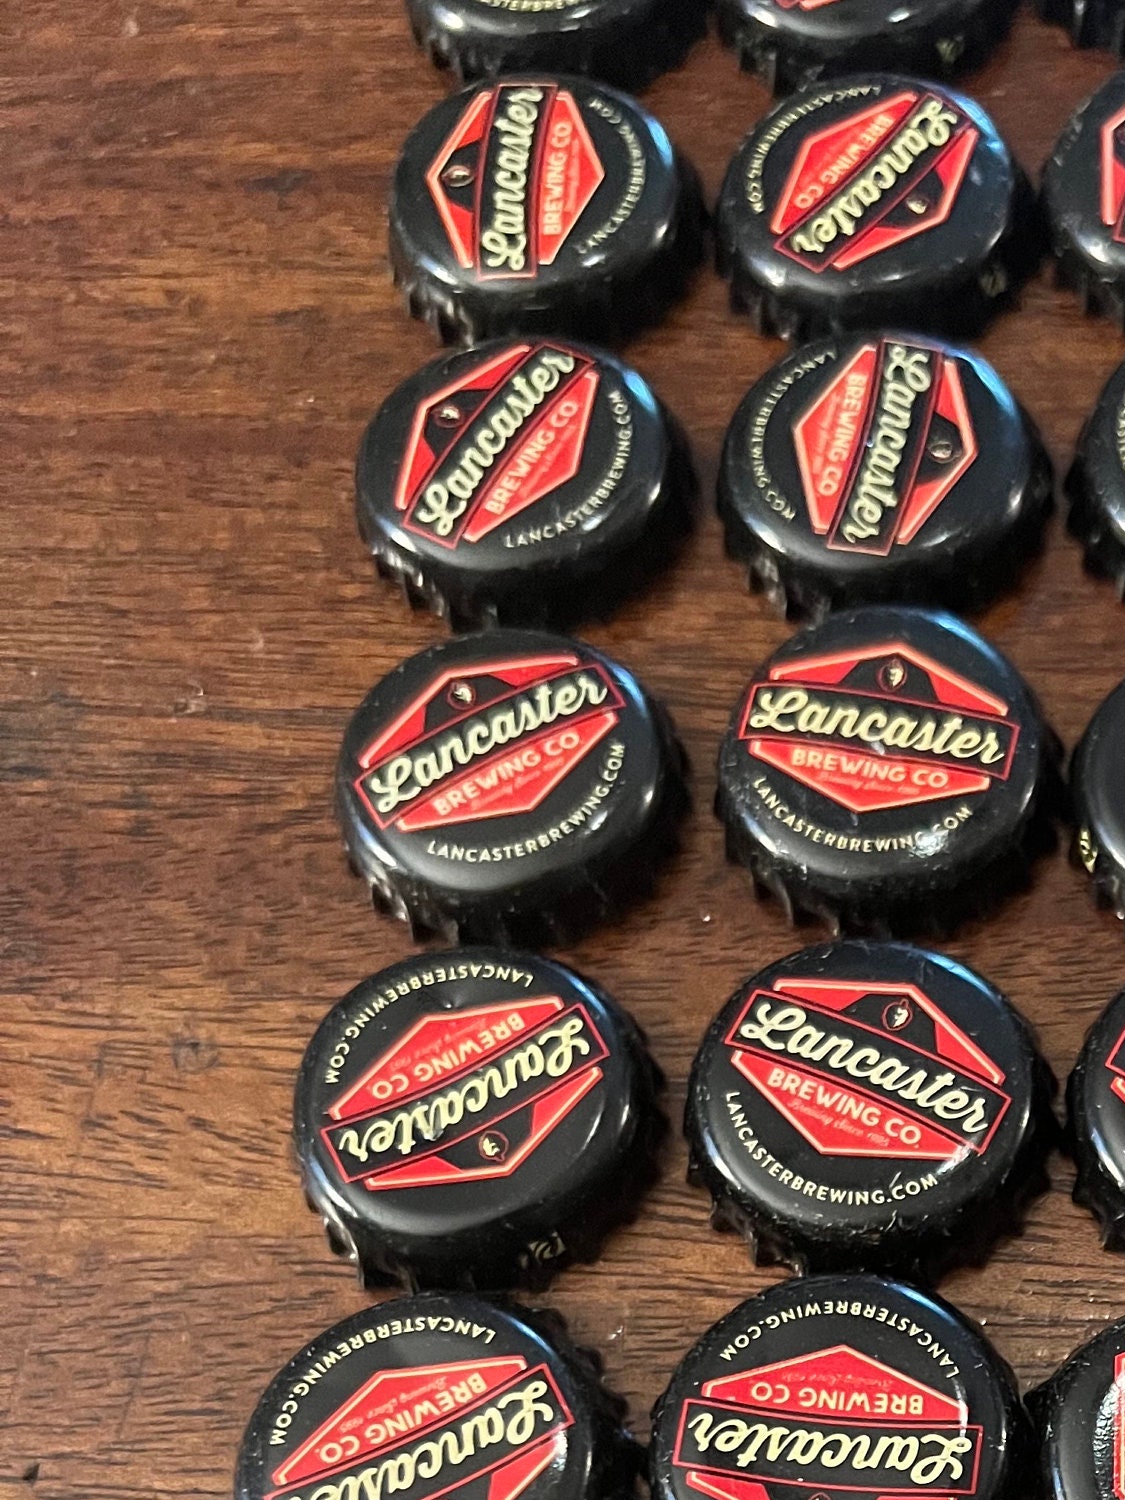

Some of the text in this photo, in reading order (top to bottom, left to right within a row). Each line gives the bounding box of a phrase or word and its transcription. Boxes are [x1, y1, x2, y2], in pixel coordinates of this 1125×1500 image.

[481, 88, 542, 268] Lancaster
[796, 101, 957, 250] Lancaster
[418, 355, 572, 533] Lancaster
[841, 347, 928, 542] Lancaster
[371, 677, 604, 811] Lancaster
[433, 751, 540, 815] BREWING
[748, 692, 1005, 765] Lancaster
[789, 748, 903, 780] BREWING
[425, 744, 624, 860] LANCASTERBREWING.COM
[327, 964, 533, 1084] LANCASTERBREWING.COM
[412, 1012, 525, 1079] BREWING
[739, 1003, 988, 1132] Lancaster
[341, 1019, 590, 1161] Lancaster
[767, 1067, 881, 1126] BREWING
[725, 1092, 938, 1204] LANCASTERBREWING.COM
[271, 1317, 496, 1444] LANCASTERBREWING.COM
[720, 1300, 960, 1377] LANCASTERBREWING.COM
[364, 1372, 485, 1442] BREWING
[689, 1414, 973, 1484] Lancaster
[797, 1387, 923, 1415] BREWING
